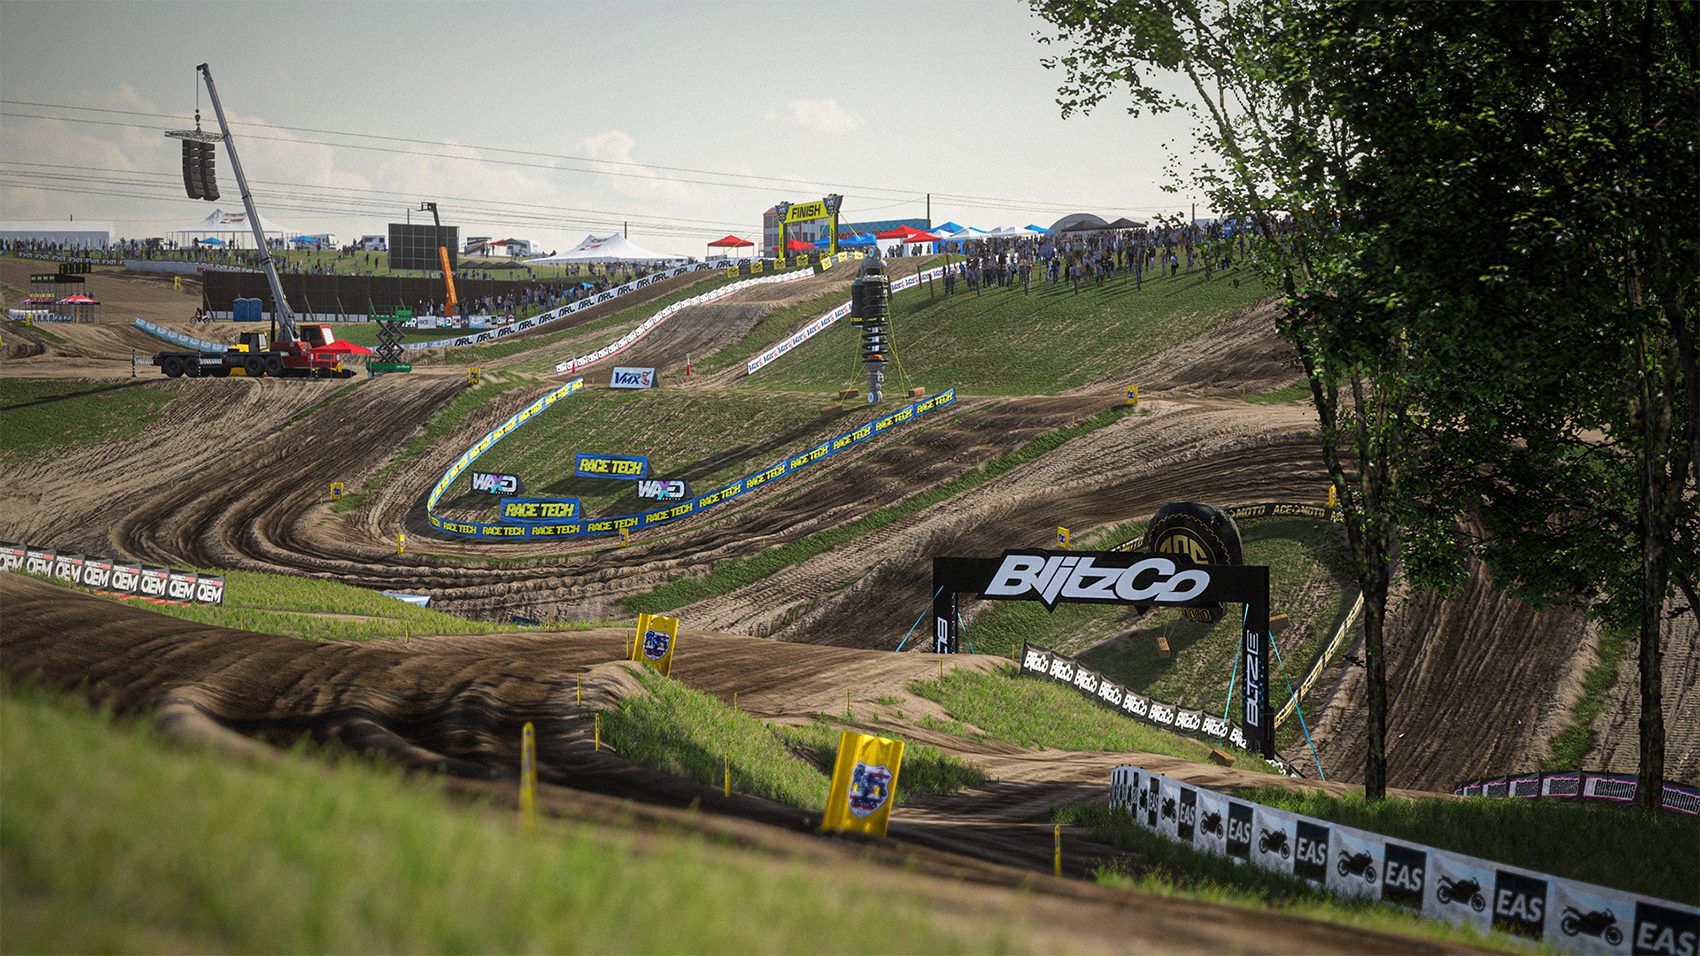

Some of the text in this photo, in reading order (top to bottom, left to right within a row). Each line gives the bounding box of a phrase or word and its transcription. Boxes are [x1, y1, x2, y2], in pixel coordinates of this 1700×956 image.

[791, 203, 821, 219] FINISH
[696, 263, 712, 272] ARL
[652, 272, 669, 283] ARL
[598, 292, 614, 302] ARL
[617, 285, 633, 296] ARL
[559, 307, 575, 317] ARL
[578, 299, 594, 310] ARL
[518, 320, 536, 330] ARL
[539, 314, 555, 324] ARL
[477, 333, 494, 342] ARL
[498, 327, 515, 337] ARL
[455, 338, 473, 346] ARL
[917, 392, 953, 413] RACE TECH
[876, 408, 912, 431] RACE TECH
[834, 426, 871, 449] RACE TECH
[579, 458, 642, 474] RACE TECH
[790, 446, 828, 469] RACE TECH
[746, 464, 785, 488] RACE TECH
[699, 484, 741, 507] RACE TECH
[505, 503, 575, 517] RACE TECH
[646, 503, 693, 523] RACE TECH
[1273, 505, 1292, 515] ACE
[444, 523, 476, 534] RACE TECH
[482, 527, 525, 535] RACE TECH
[532, 525, 580, 535] RACE TECH
[587, 518, 638, 532] RACE TECH
[55, 562, 81, 582] OEM
[84, 566, 110, 588] OEM
[112, 571, 139, 591] OEM
[984, 555, 1210, 605] BlitzCo
[141, 576, 166, 595] OEM
[169, 580, 195, 599] OEM
[197, 584, 222, 603] OEM
[1180, 803, 1195, 826] EAS
[1228, 818, 1251, 843] EAS
[1297, 837, 1327, 866] EAS
[1384, 861, 1423, 892] EAS
[1496, 889, 1542, 922] EAS
[1637, 922, 1696, 956] EAS
